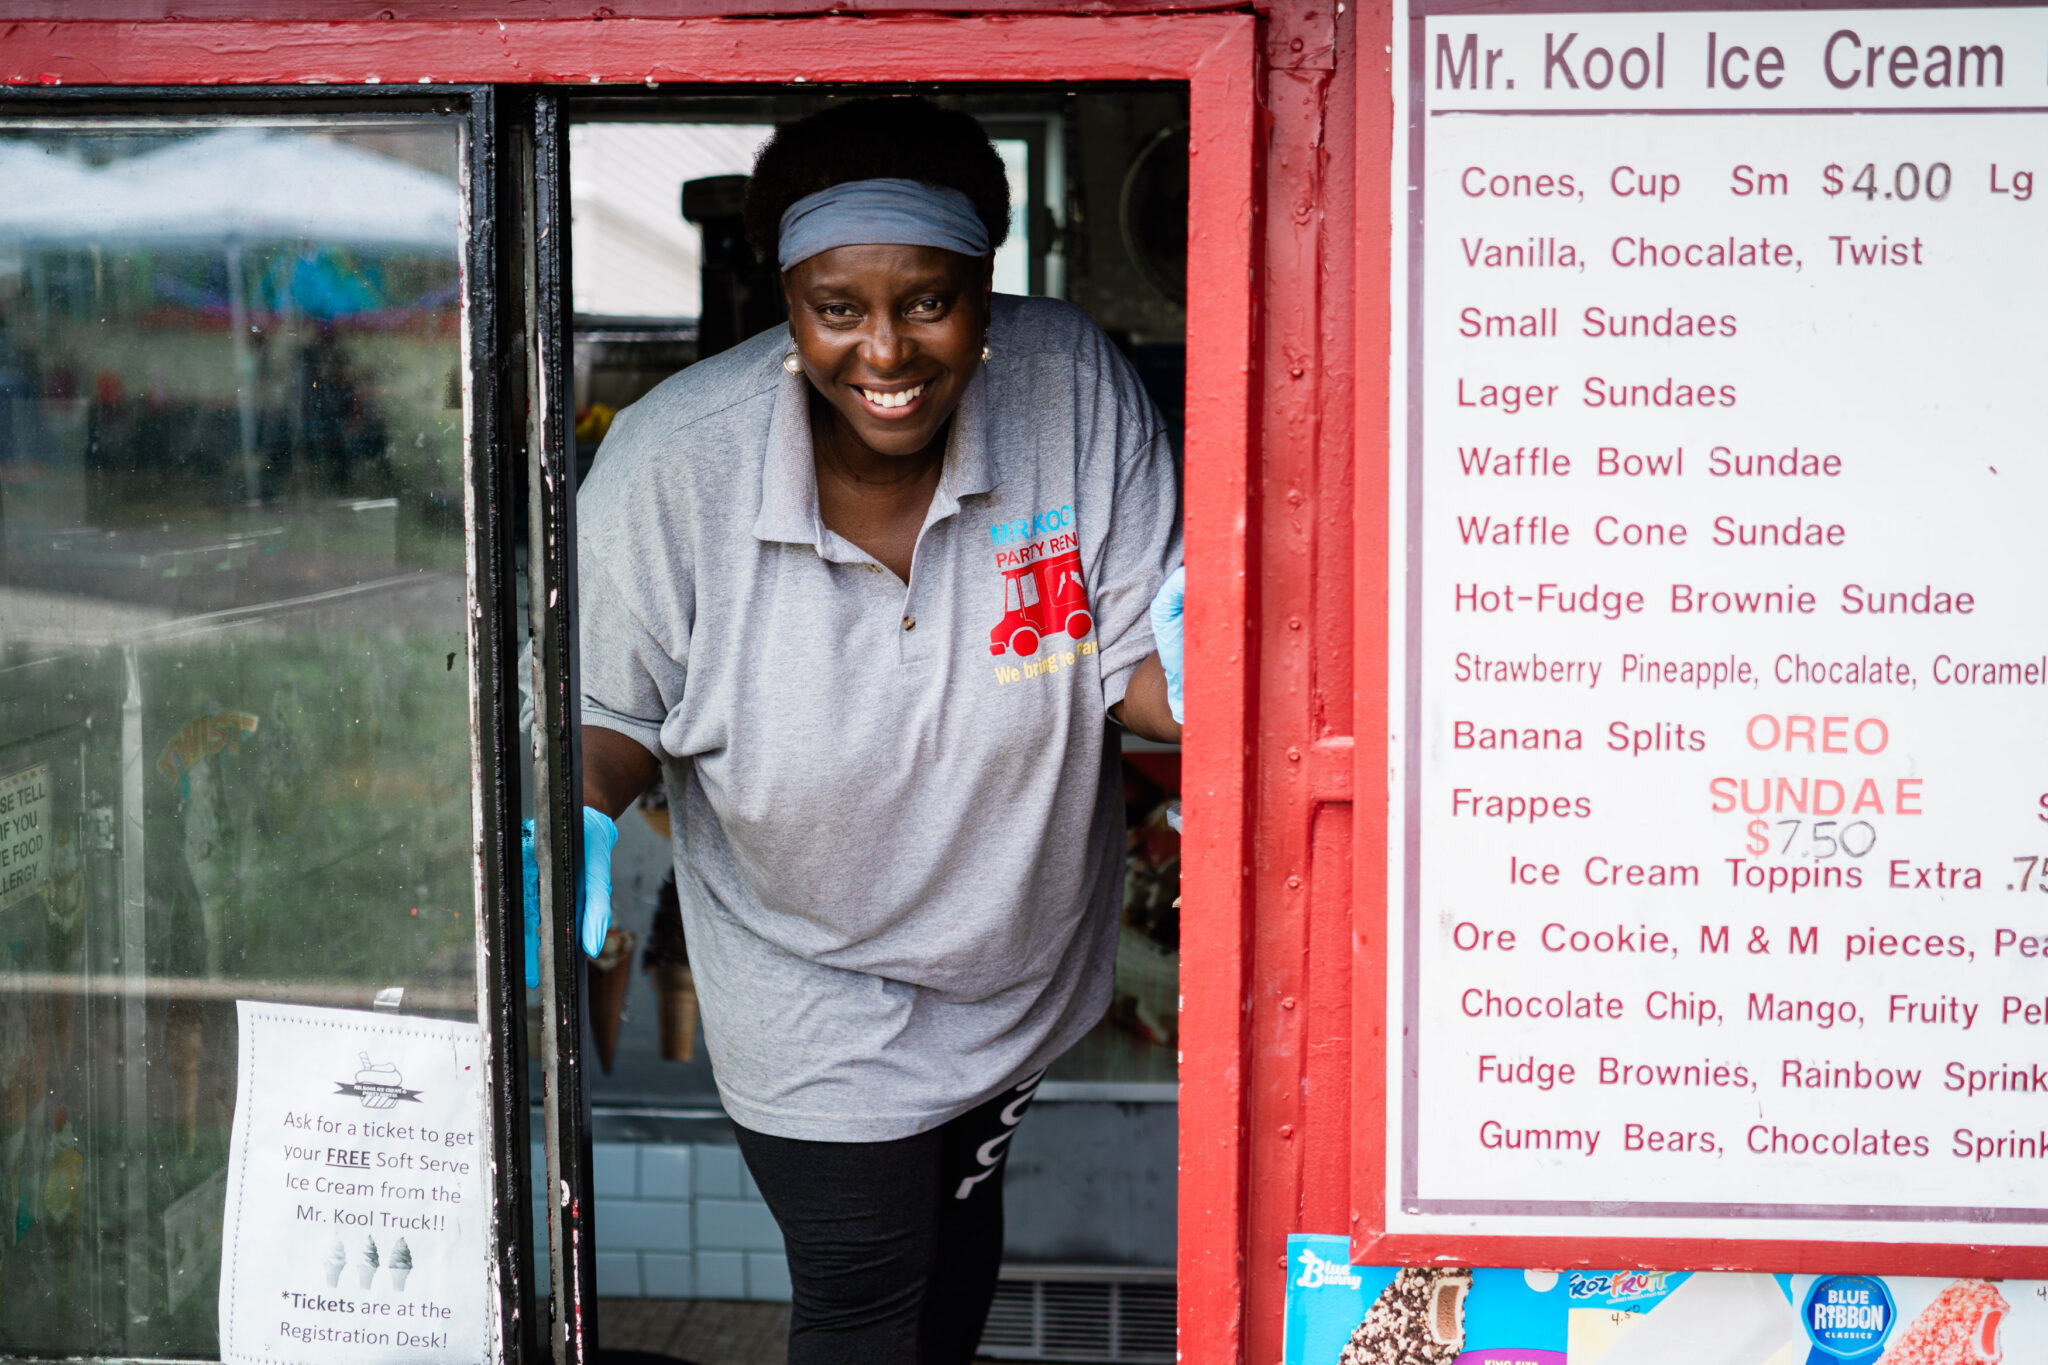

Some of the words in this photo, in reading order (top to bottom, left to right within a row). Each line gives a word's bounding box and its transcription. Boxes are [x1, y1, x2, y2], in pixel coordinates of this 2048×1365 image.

[1436, 33, 1515, 90] Mr.
[1544, 31, 1665, 91] Kool
[1707, 31, 1785, 90] Ice
[1823, 29, 2004, 90] Cream
[1461, 166, 1584, 201] Cones,
[1610, 165, 1681, 203] Cup
[1730, 164, 1788, 197] Sm
[1822, 161, 1952, 202] $4.00
[1990, 163, 2033, 202] Lg
[1460, 237, 1585, 273] Vanilla,
[1611, 236, 1802, 273] Chocalate,
[1828, 234, 1923, 266] Twist
[1459, 306, 1557, 338] Small
[1583, 306, 1737, 338] Sundaes
[1458, 378, 1559, 415] Lager
[1583, 376, 1737, 408] Sundaes
[1458, 447, 1571, 477] Waffle
[1598, 447, 1683, 477] Bowl
[1708, 446, 1842, 477] Sundae
[1457, 515, 1570, 546] Waffle
[1594, 515, 1688, 546] Cone
[1712, 515, 1846, 546] Sundae
[995, 540, 1045, 569] PARTY
[1049, 531, 1079, 554] REN
[1455, 583, 1644, 621] Hot-Fudge
[1671, 584, 1816, 614] Brownie
[1841, 583, 1975, 615] Sundae
[994, 665, 1021, 685] We
[1454, 652, 1603, 689] Strawberry
[1622, 653, 1759, 690] Pineapple,
[1774, 653, 1917, 691] Chocalate,
[1932, 654, 2047, 686] Coramel
[1454, 720, 1582, 751] Banana
[1607, 721, 1706, 757] Splits
[1746, 713, 1889, 756] OREO
[17, 782, 46, 806] TELL
[1452, 788, 1591, 824] Frappes
[1709, 776, 1924, 817] SUNDAE
[12, 810, 38, 835] YOU
[13, 834, 44, 863] FOOD
[0, 862, 39, 895] LERGY
[1510, 855, 1560, 885] Ice
[1584, 856, 1699, 887] Cream
[1725, 858, 1863, 894] Toppins
[1889, 859, 1982, 890] Extra
[1452, 921, 1516, 952] Ore
[1541, 922, 1678, 958] Cookie,
[1700, 925, 1729, 954] M
[1747, 925, 1770, 955] &
[1789, 926, 1818, 955] M
[1846, 926, 1975, 962] pieces,
[1461, 988, 1624, 1020] Chocolate
[1646, 990, 1723, 1027] Chip,
[1748, 992, 1864, 1029] Mango,
[1889, 994, 1979, 1030] Fruity
[1479, 1054, 1576, 1091] Fudge
[1599, 1056, 1757, 1091] Brownies,
[1782, 1059, 1922, 1090] Rainbow
[1944, 1061, 2048, 1097] Sprink
[283, 1111, 312, 1131] Ask
[317, 1115, 343, 1134] for
[347, 1123, 357, 1136] a
[362, 1121, 415, 1140] ticket
[420, 1127, 439, 1143] to
[444, 1131, 475, 1148] get
[1479, 1120, 1601, 1157] Gummy
[1624, 1123, 1724, 1156] Bears,
[1747, 1124, 1930, 1157] Chocolates
[284, 1144, 322, 1161] your
[324, 1147, 371, 1170] FREE
[376, 1151, 414, 1170] Soft
[419, 1154, 470, 1175] Serve
[286, 1172, 310, 1191] Ice
[315, 1176, 374, 1197] Cream
[380, 1180, 425, 1201] from
[431, 1185, 461, 1204] the
[296, 1204, 327, 1222] Mr.
[333, 1208, 374, 1227] Kool
[379, 1212, 445, 1230] Truck!!
[360, 1302, 391, 1316] are
[396, 1302, 415, 1317] at
[420, 1301, 452, 1320] the
[1827, 1289, 1870, 1305] BLUE
[280, 1321, 389, 1346] Registration
[396, 1330, 447, 1349] Desk!
[1814, 1303, 1884, 1331] RIBBON
[1824, 1331, 1873, 1340] CLASSICS
